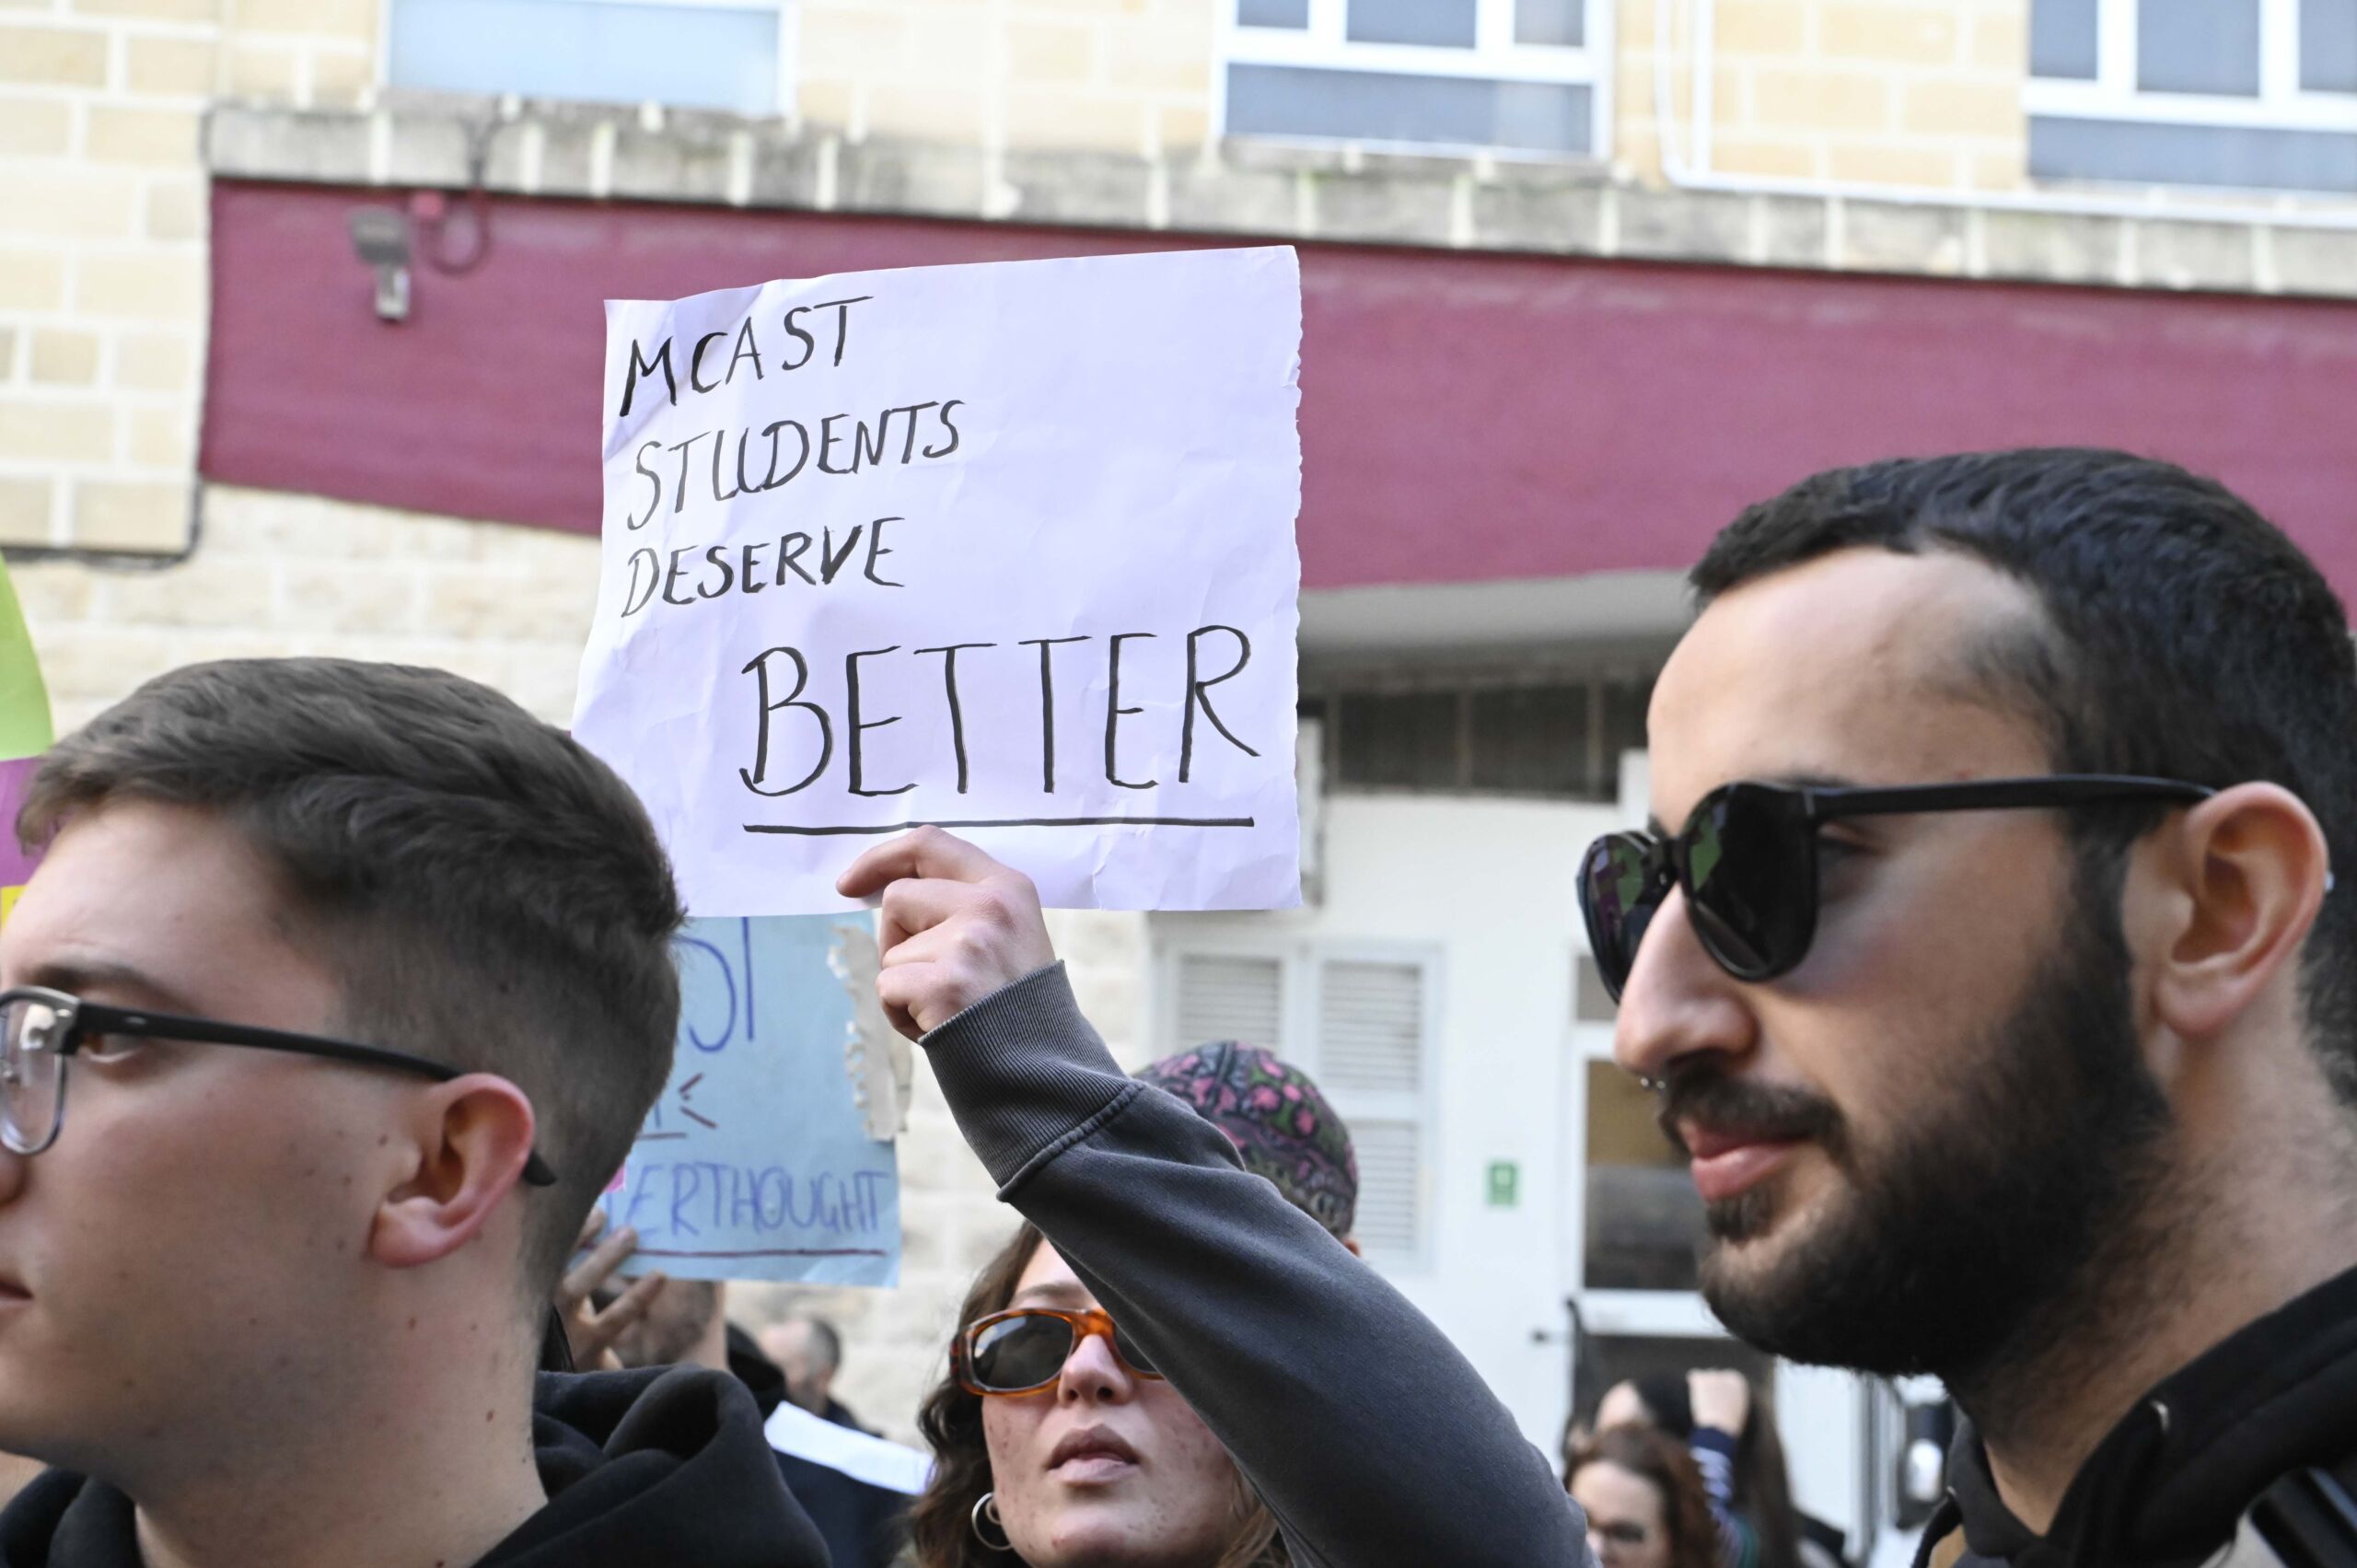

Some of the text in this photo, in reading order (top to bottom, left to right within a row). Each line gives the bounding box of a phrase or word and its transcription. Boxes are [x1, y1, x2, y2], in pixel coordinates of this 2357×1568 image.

[619, 296, 874, 417] MCAST
[626, 400, 966, 531] STUDENTS
[621, 517, 905, 618] DESERVE
[738, 624, 1261, 797] BETTER
